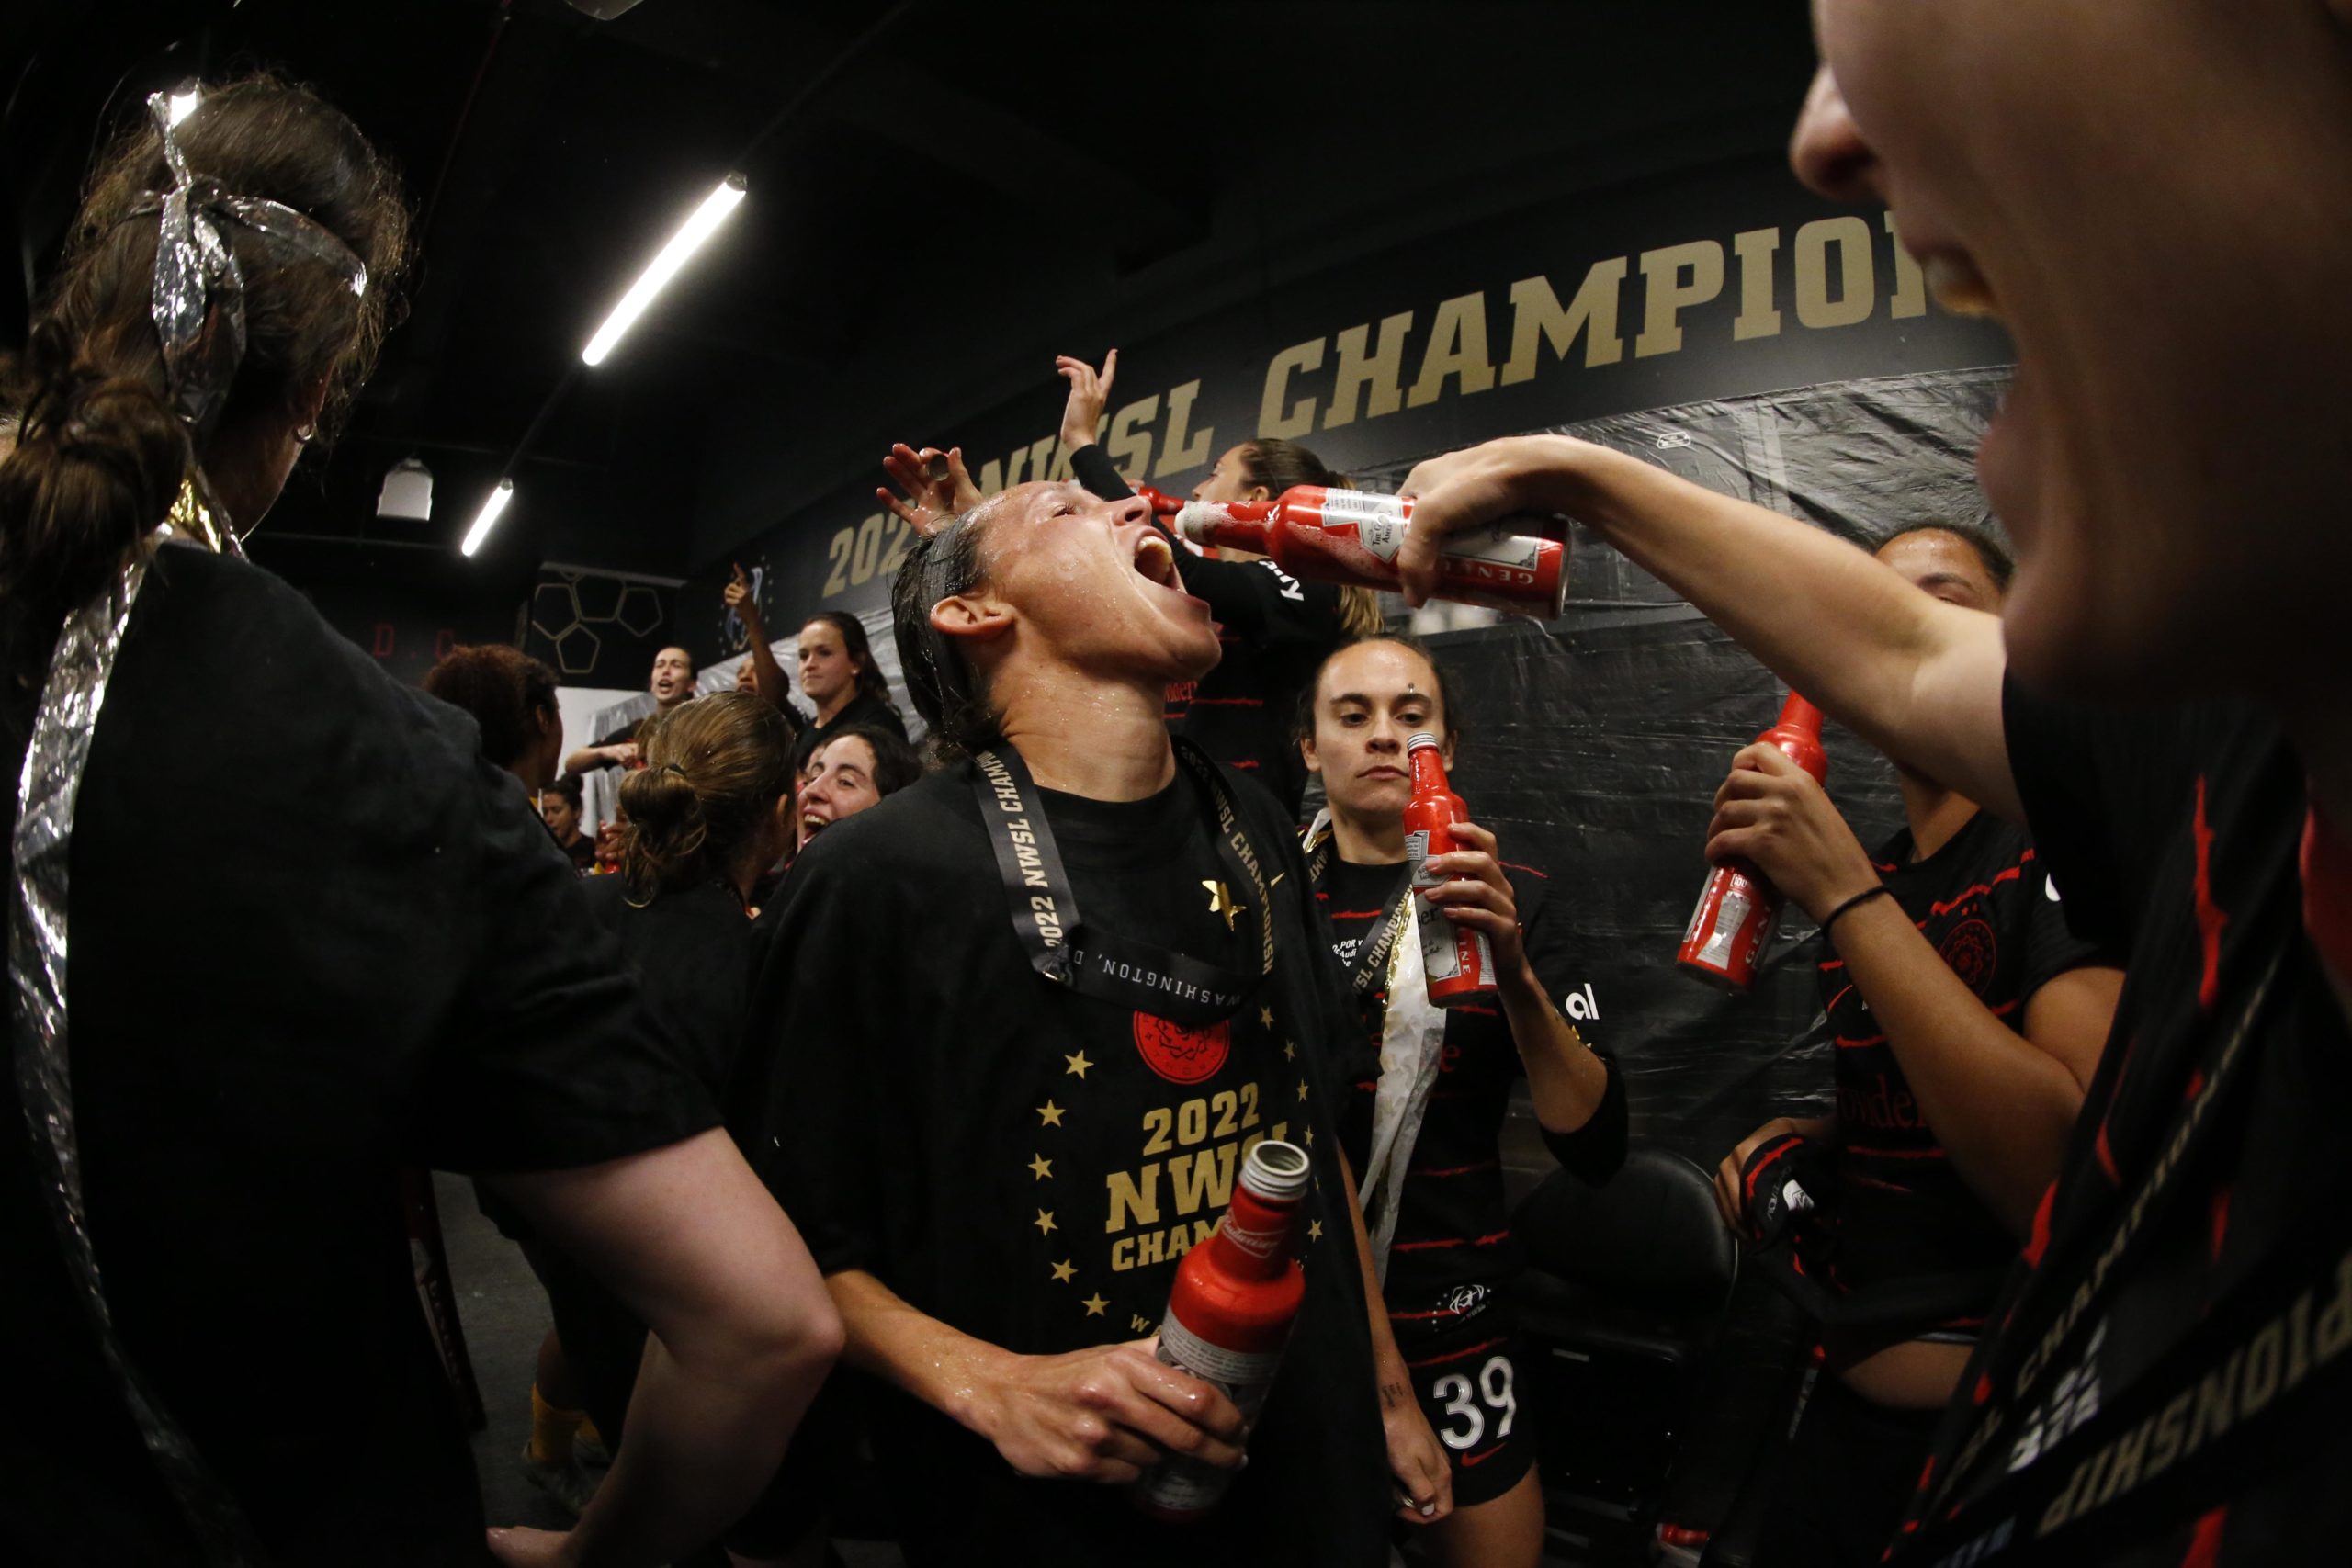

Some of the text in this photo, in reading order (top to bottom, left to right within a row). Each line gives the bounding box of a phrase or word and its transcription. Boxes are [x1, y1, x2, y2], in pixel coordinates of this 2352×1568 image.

[822, 498, 918, 598] 202
[1008, 818, 1049, 889] NWSL
[1340, 939, 1357, 950] POR
[1141, 1081, 1261, 1157] 2022
[1105, 1121, 1288, 1234] NW
[1433, 1355, 1518, 1450] 39
